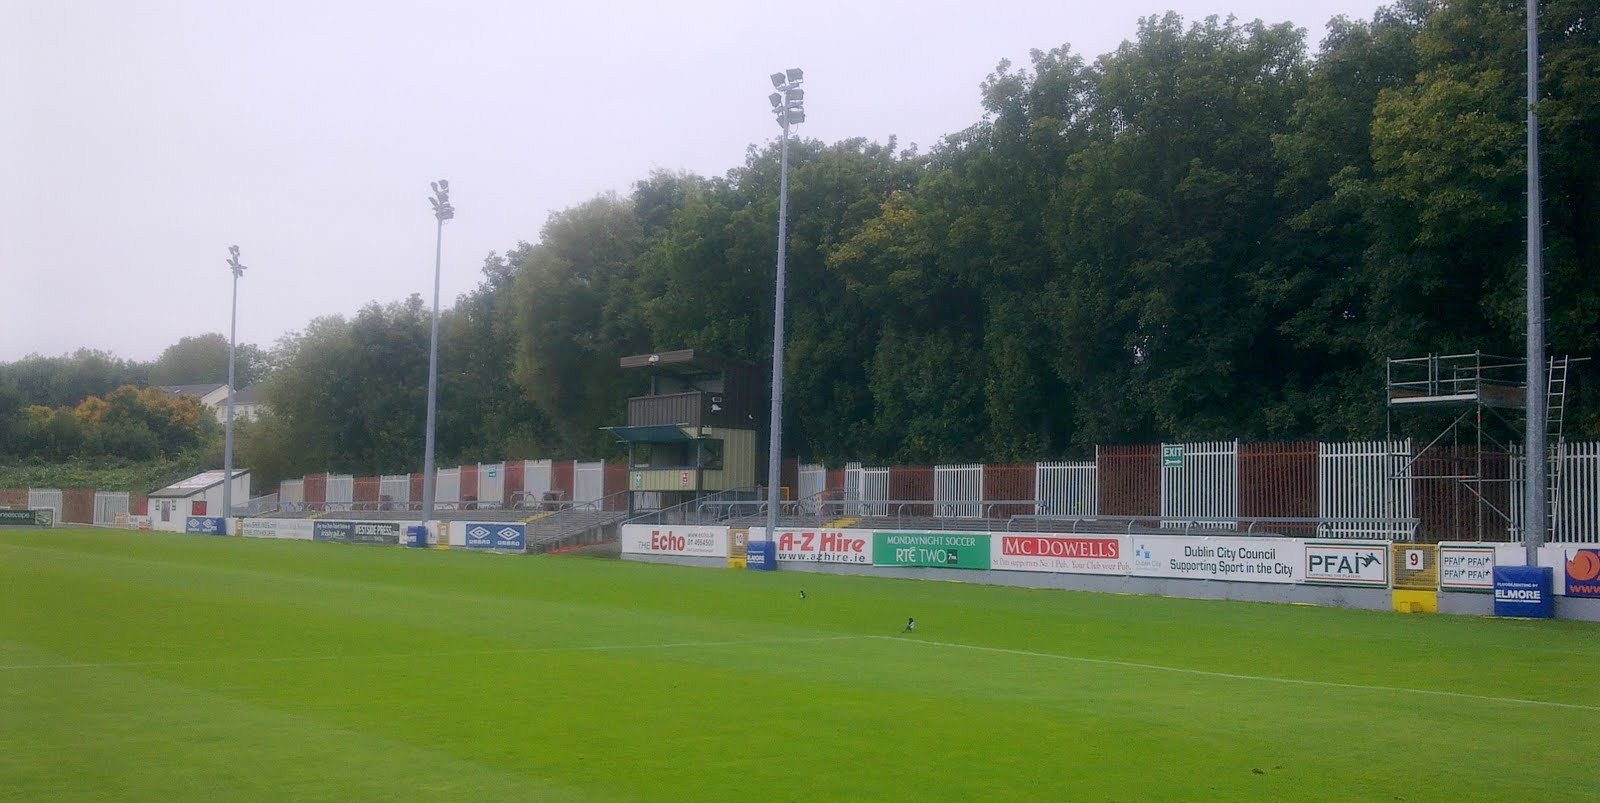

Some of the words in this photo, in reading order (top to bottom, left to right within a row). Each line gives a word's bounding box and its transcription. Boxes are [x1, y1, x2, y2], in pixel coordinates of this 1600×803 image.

[1164, 447, 1182, 457] EXIT
[638, 541, 650, 550] THE
[651, 530, 685, 551] Echo
[778, 532, 815, 552] A-Z
[820, 532, 866, 553] Hire
[945, 537, 976, 547] SOCCER
[1037, 538, 1117, 557] DOWELLS
[778, 552, 866, 563] www.azhire.ie
[919, 548, 947, 563] TWO
[1184, 546, 1214, 558] Dublin
[1217, 547, 1236, 561] City
[1238, 548, 1276, 560] Council
[1410, 553, 1419, 566] 9
[1170, 559, 1217, 574] Supporting
[1219, 561, 1245, 575] Sport
[1246, 562, 1254, 573] in
[1256, 563, 1272, 574] the
[1274, 563, 1293, 577] City
[1495, 589, 1541, 599] ELMORE
